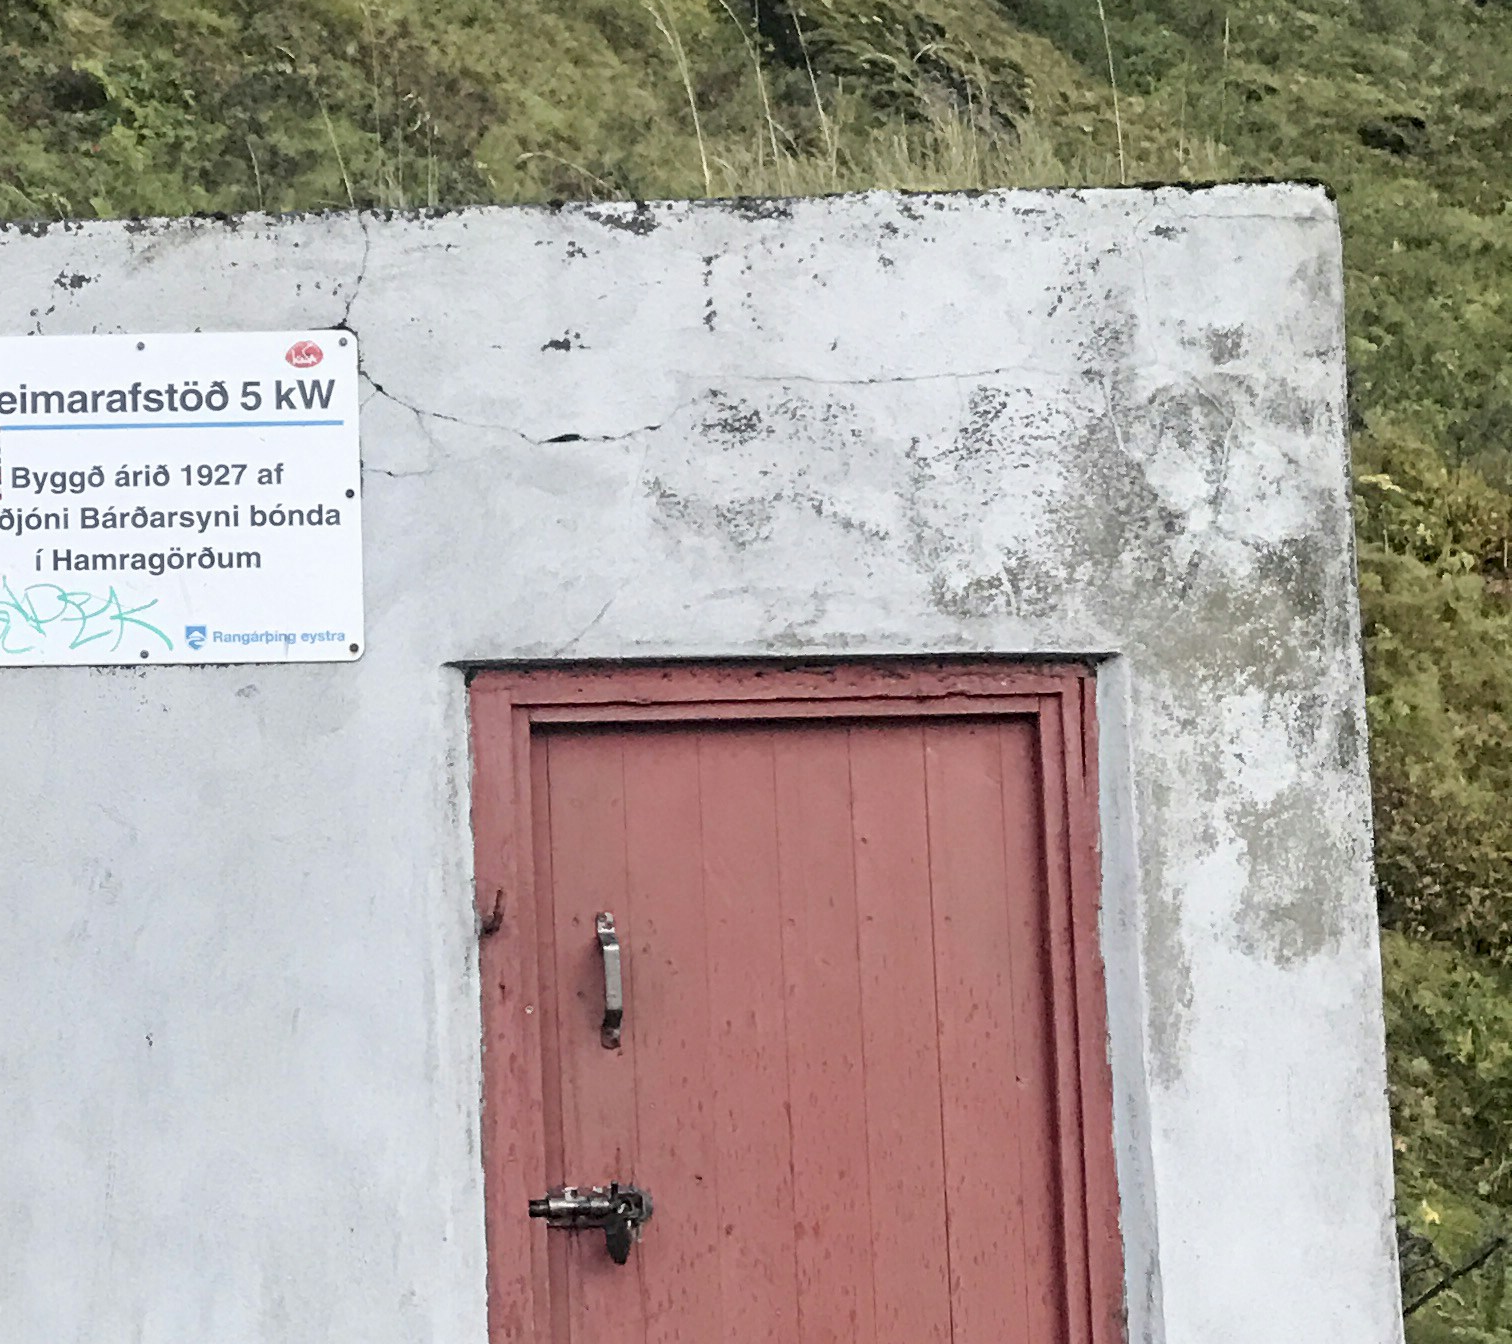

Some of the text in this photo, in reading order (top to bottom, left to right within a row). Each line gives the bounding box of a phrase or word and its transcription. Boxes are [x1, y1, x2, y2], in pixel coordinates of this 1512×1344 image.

[239, 380, 263, 411] 5
[274, 379, 336, 410] kW
[11, 462, 285, 494] Byggð árið 1927 af
[80, 504, 239, 533] Bárðarsyni
[249, 502, 342, 527] bónda
[35, 546, 262, 576] í Hamragörðum
[212, 630, 346, 645] Rangárþing eystra
